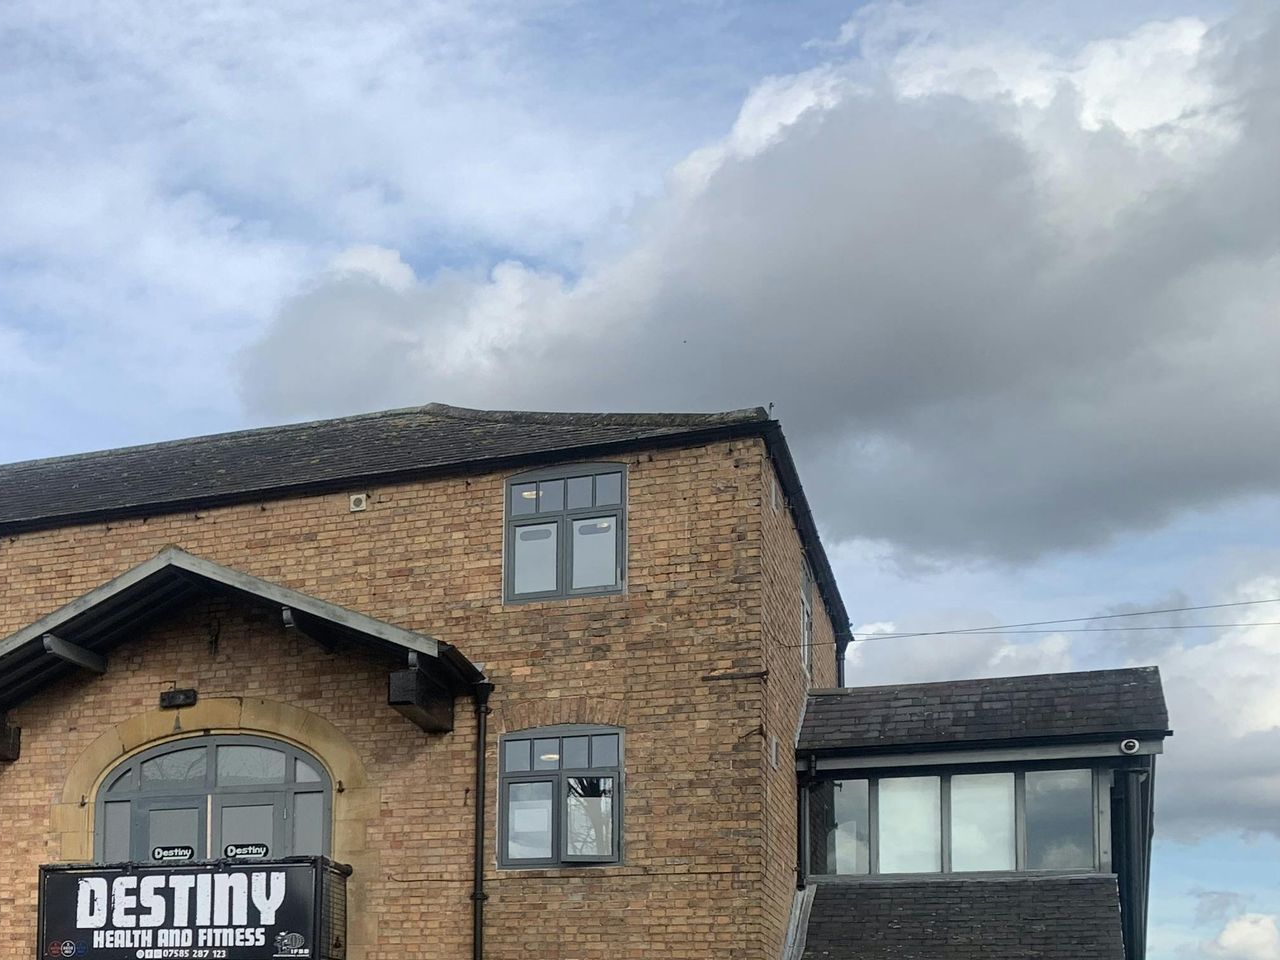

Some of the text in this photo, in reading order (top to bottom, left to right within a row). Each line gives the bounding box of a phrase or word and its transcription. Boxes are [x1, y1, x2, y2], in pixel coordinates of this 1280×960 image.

[154, 848, 192, 860] Destiny
[227, 845, 267, 858] Destiny
[76, 871, 286, 929] DESTINY
[93, 929, 153, 949] HEALTH
[157, 928, 193, 948] AND
[198, 927, 266, 947] FITNESS
[162, 949, 227, 958] 07585 287 123
